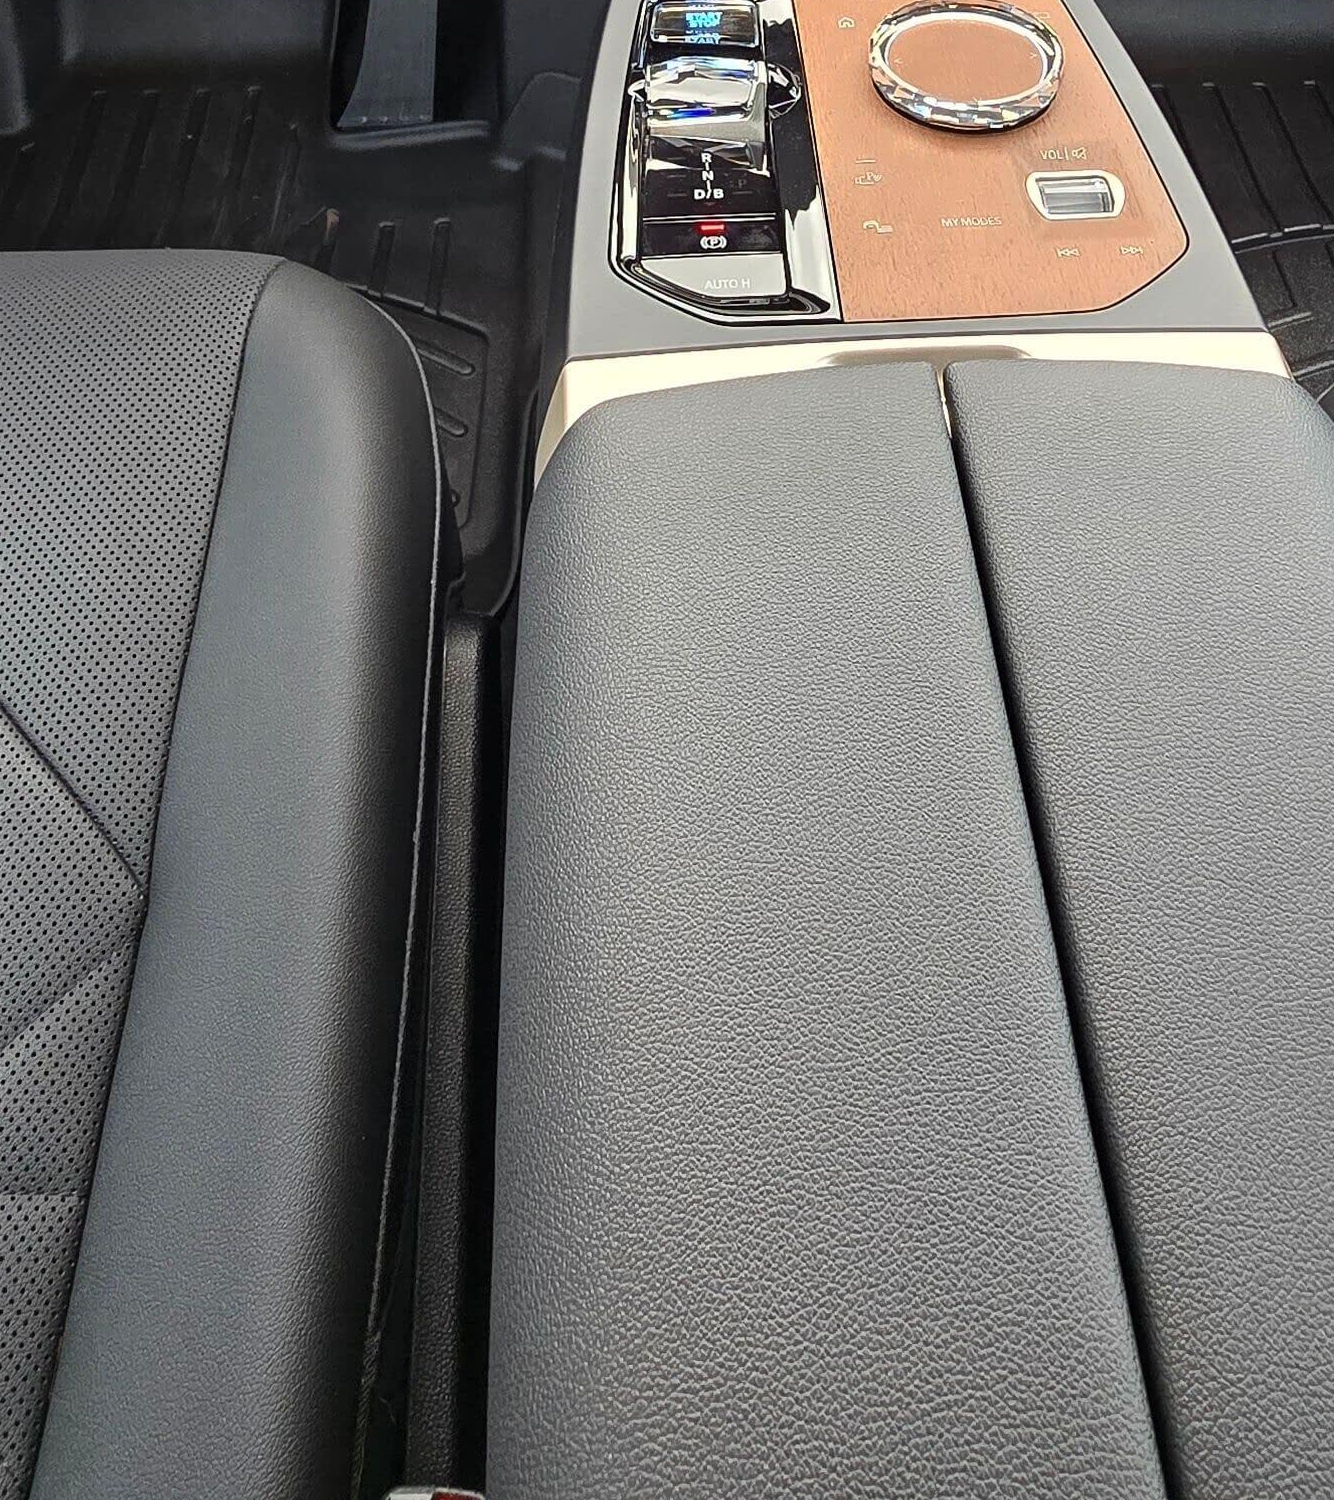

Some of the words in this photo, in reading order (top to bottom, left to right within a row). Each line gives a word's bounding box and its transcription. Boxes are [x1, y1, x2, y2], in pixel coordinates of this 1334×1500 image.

[700, 152, 713, 164] R
[1040, 149, 1063, 160] VOL
[701, 170, 714, 181] N
[940, 217, 959, 228] MY
[960, 216, 1003, 227] MODES
[704, 278, 738, 290] AUTO
[741, 277, 751, 289] H
